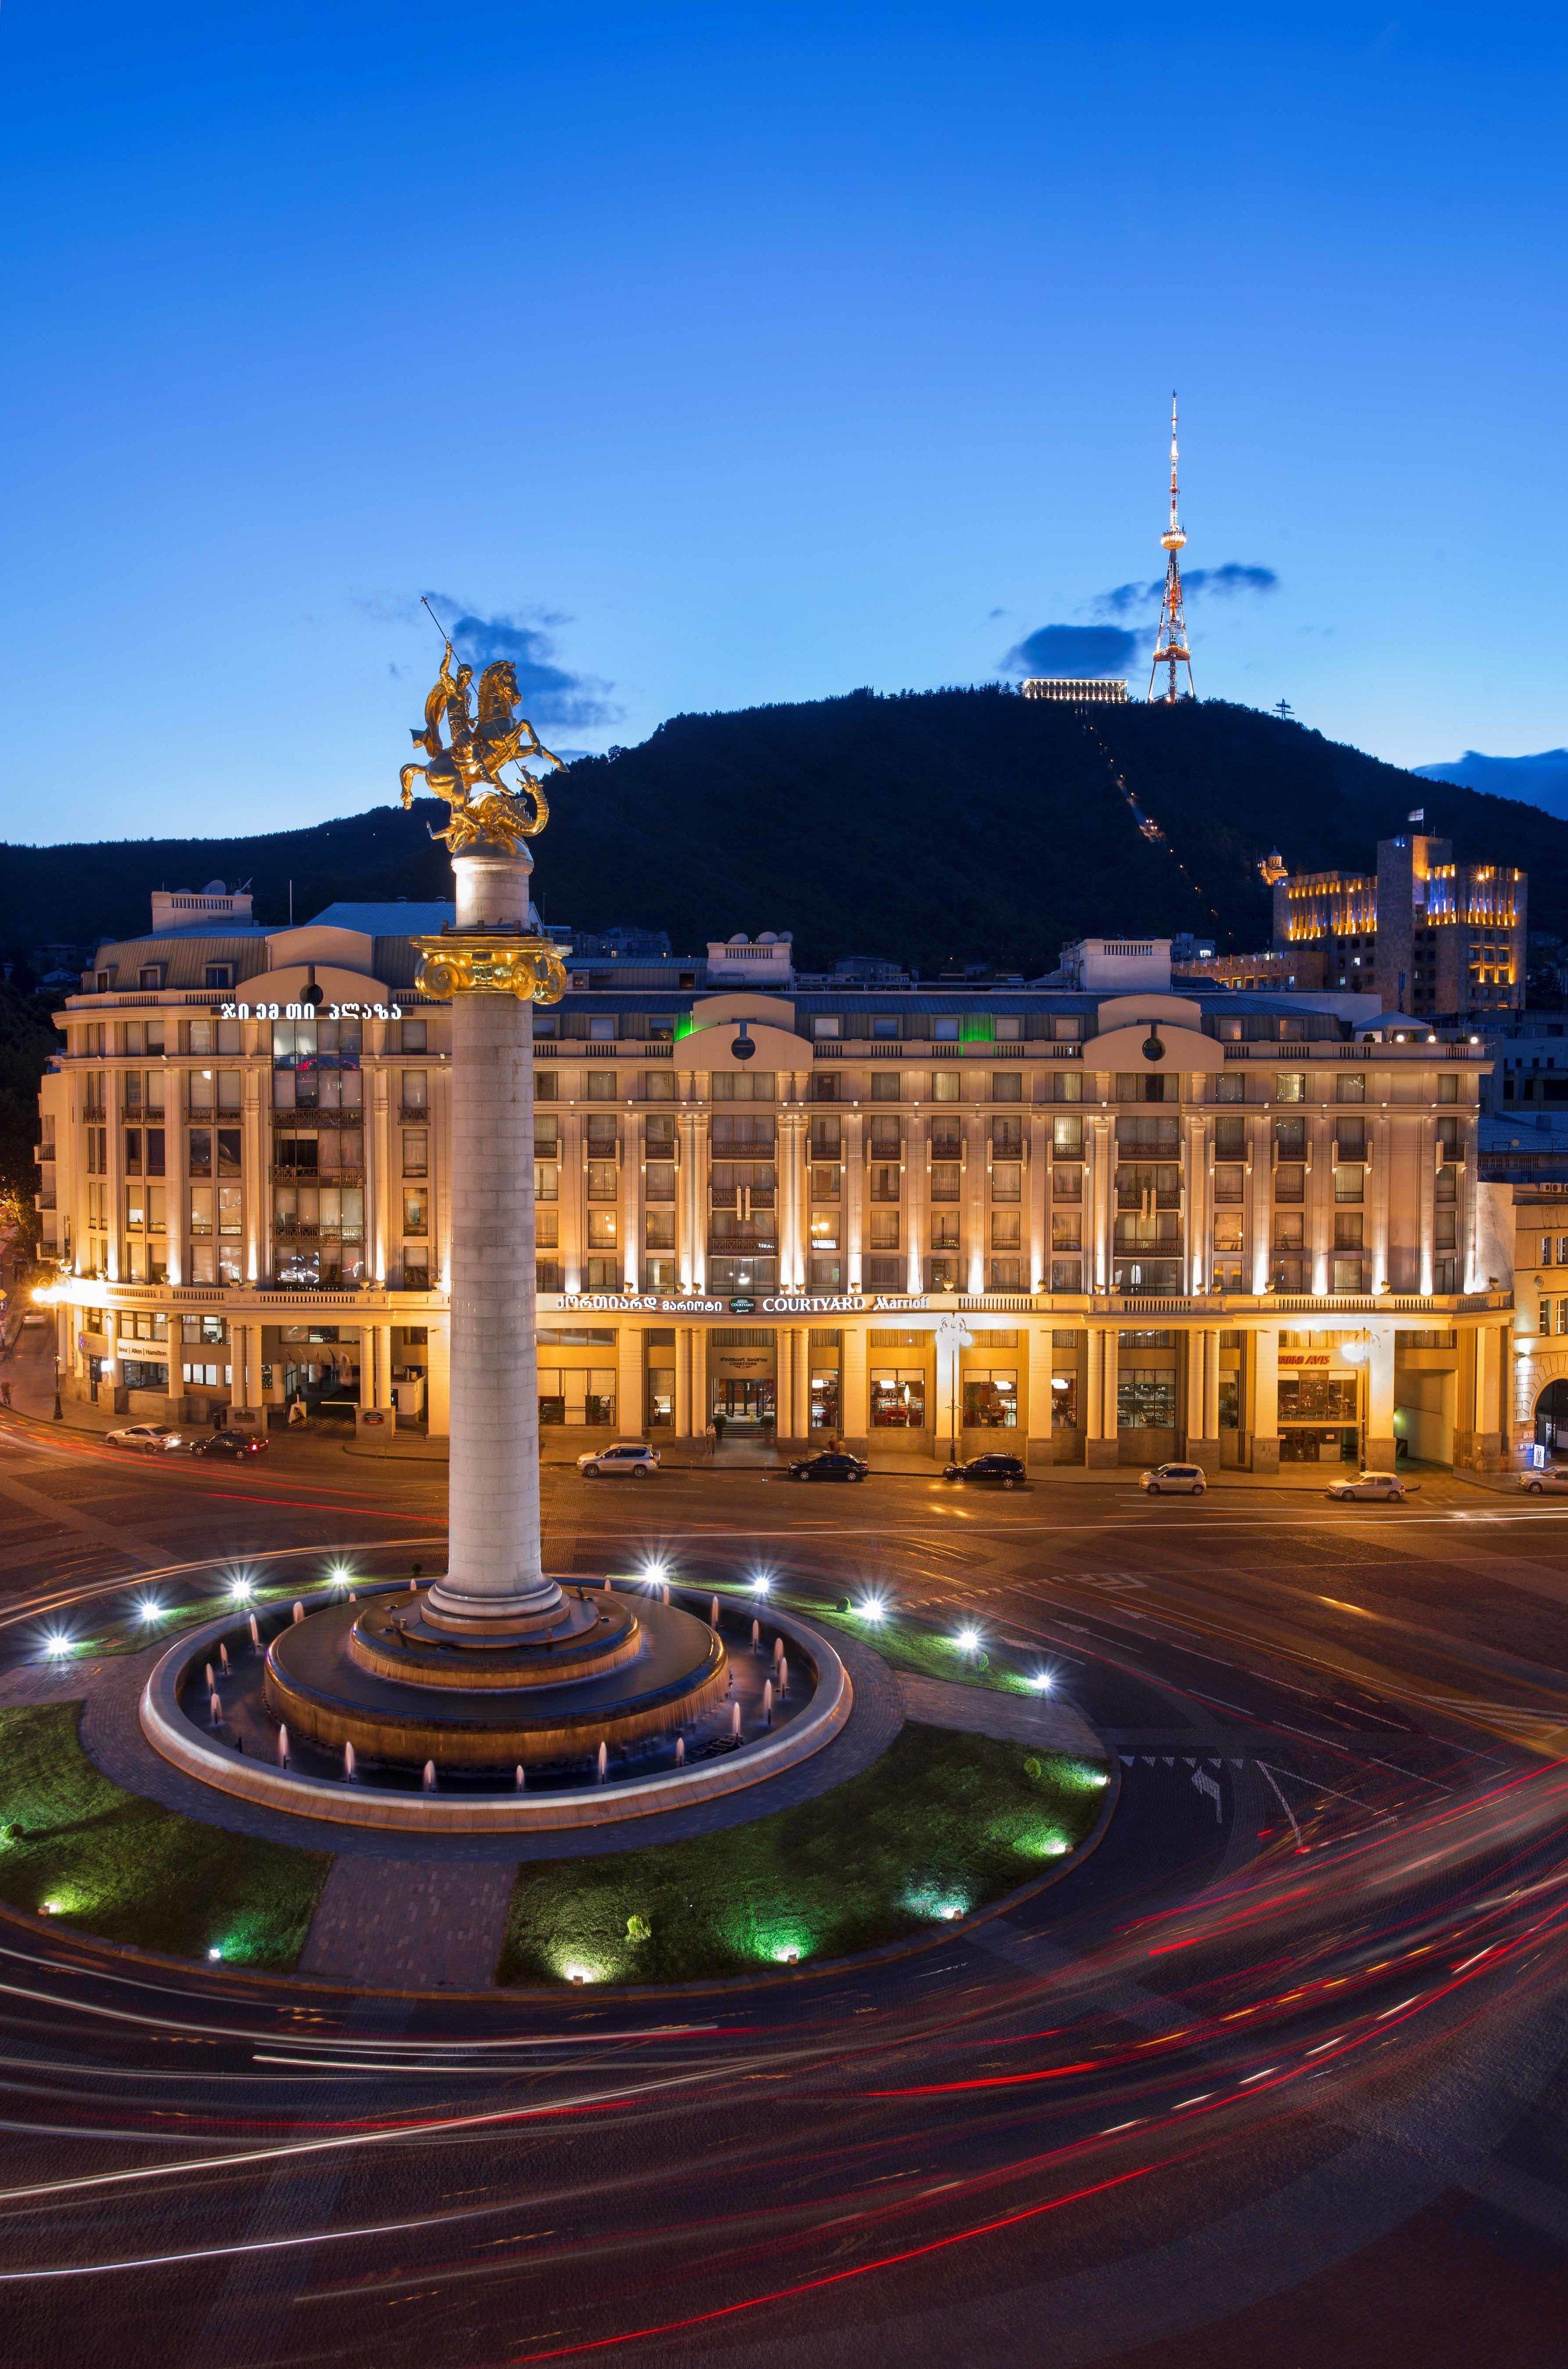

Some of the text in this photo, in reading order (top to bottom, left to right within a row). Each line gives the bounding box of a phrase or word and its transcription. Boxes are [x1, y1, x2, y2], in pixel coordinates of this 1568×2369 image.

[221, 1003, 402, 1019] ჯი ემ თი პლაზა
[662, 1300, 722, 1311] მარიოტი
[762, 1296, 930, 1312] COURTYARD Marriott
[1305, 1355, 1331, 1365] AVIS
